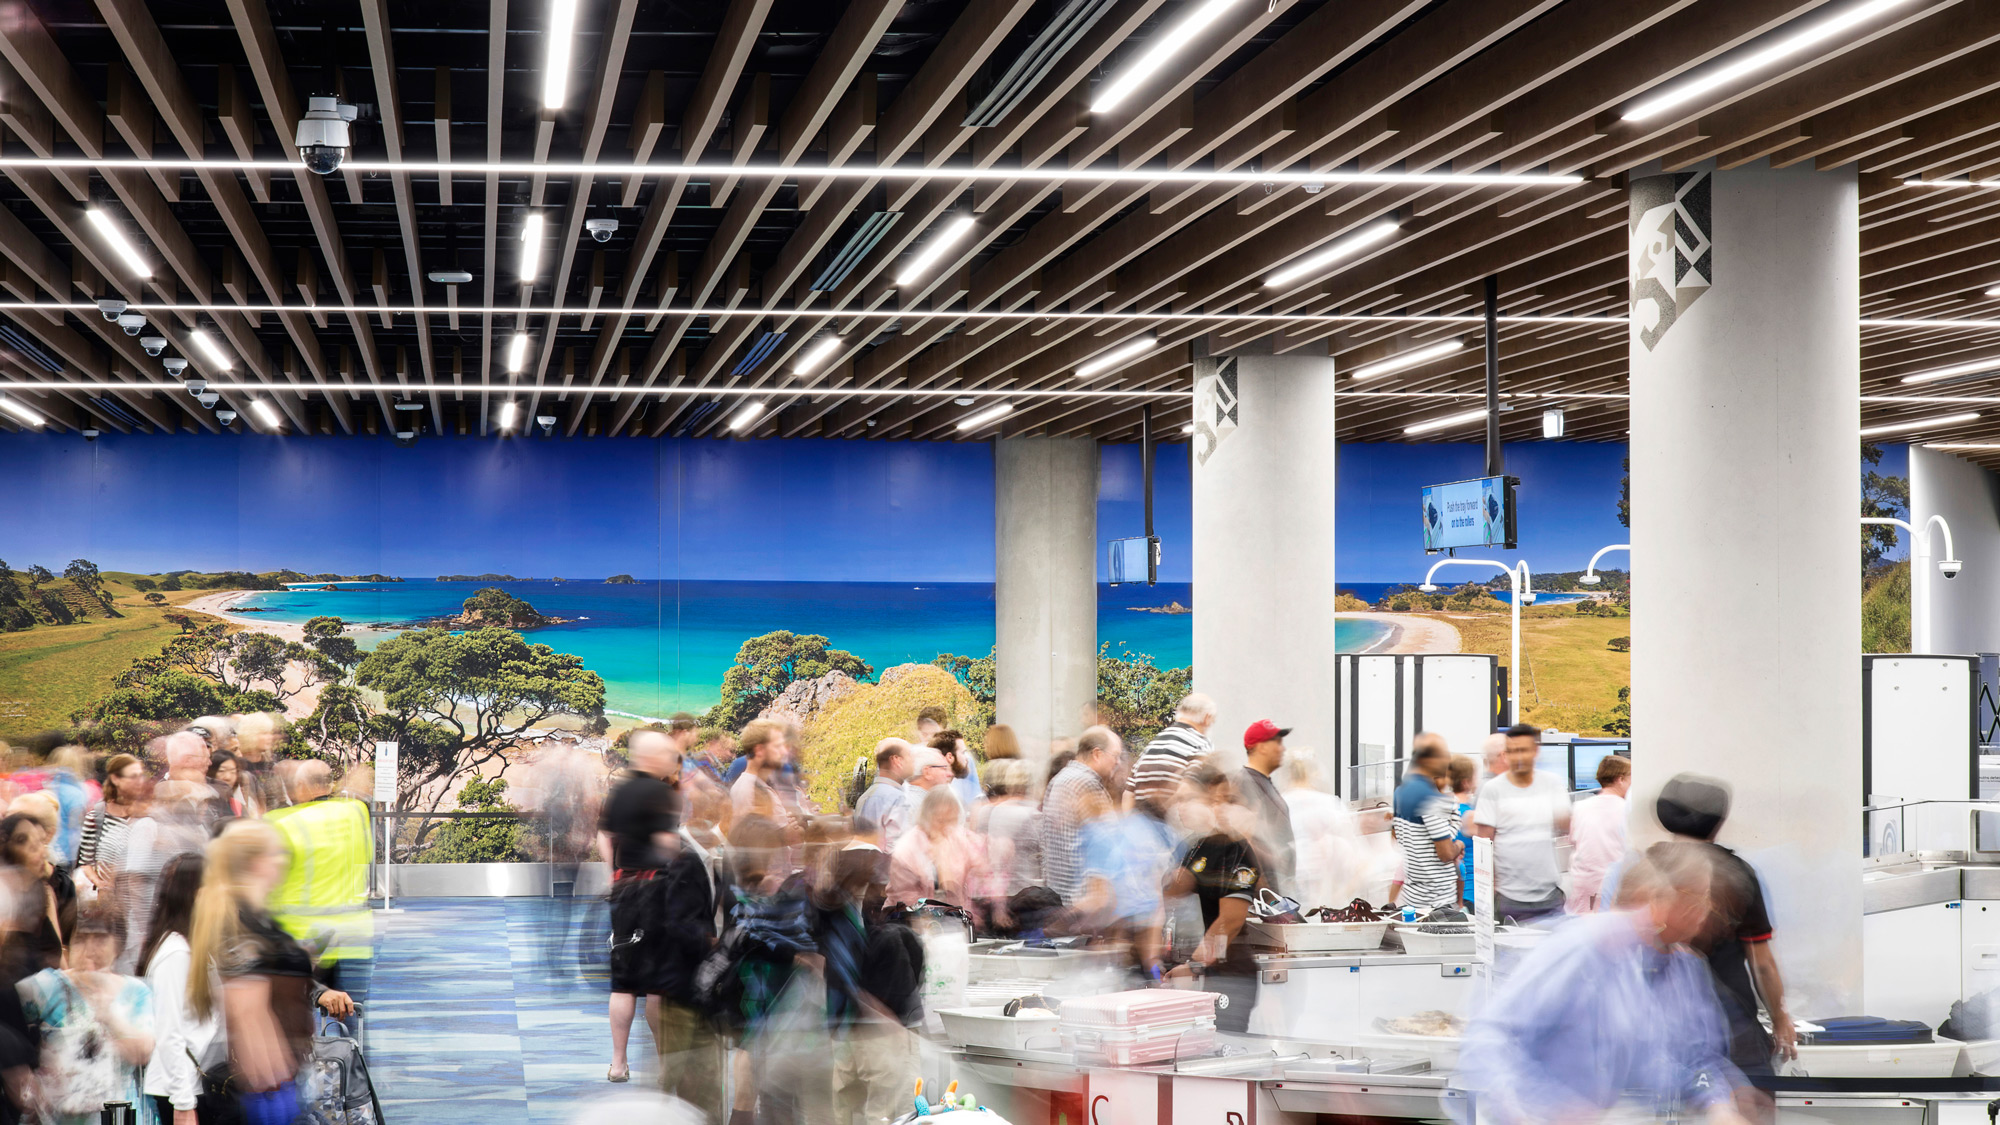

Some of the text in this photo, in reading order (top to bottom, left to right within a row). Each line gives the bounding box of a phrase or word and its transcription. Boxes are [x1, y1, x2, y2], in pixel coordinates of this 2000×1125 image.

[1446, 501, 1454, 512] Push
[1466, 498, 1478, 510] forward
[1465, 515, 1474, 526] rollers
